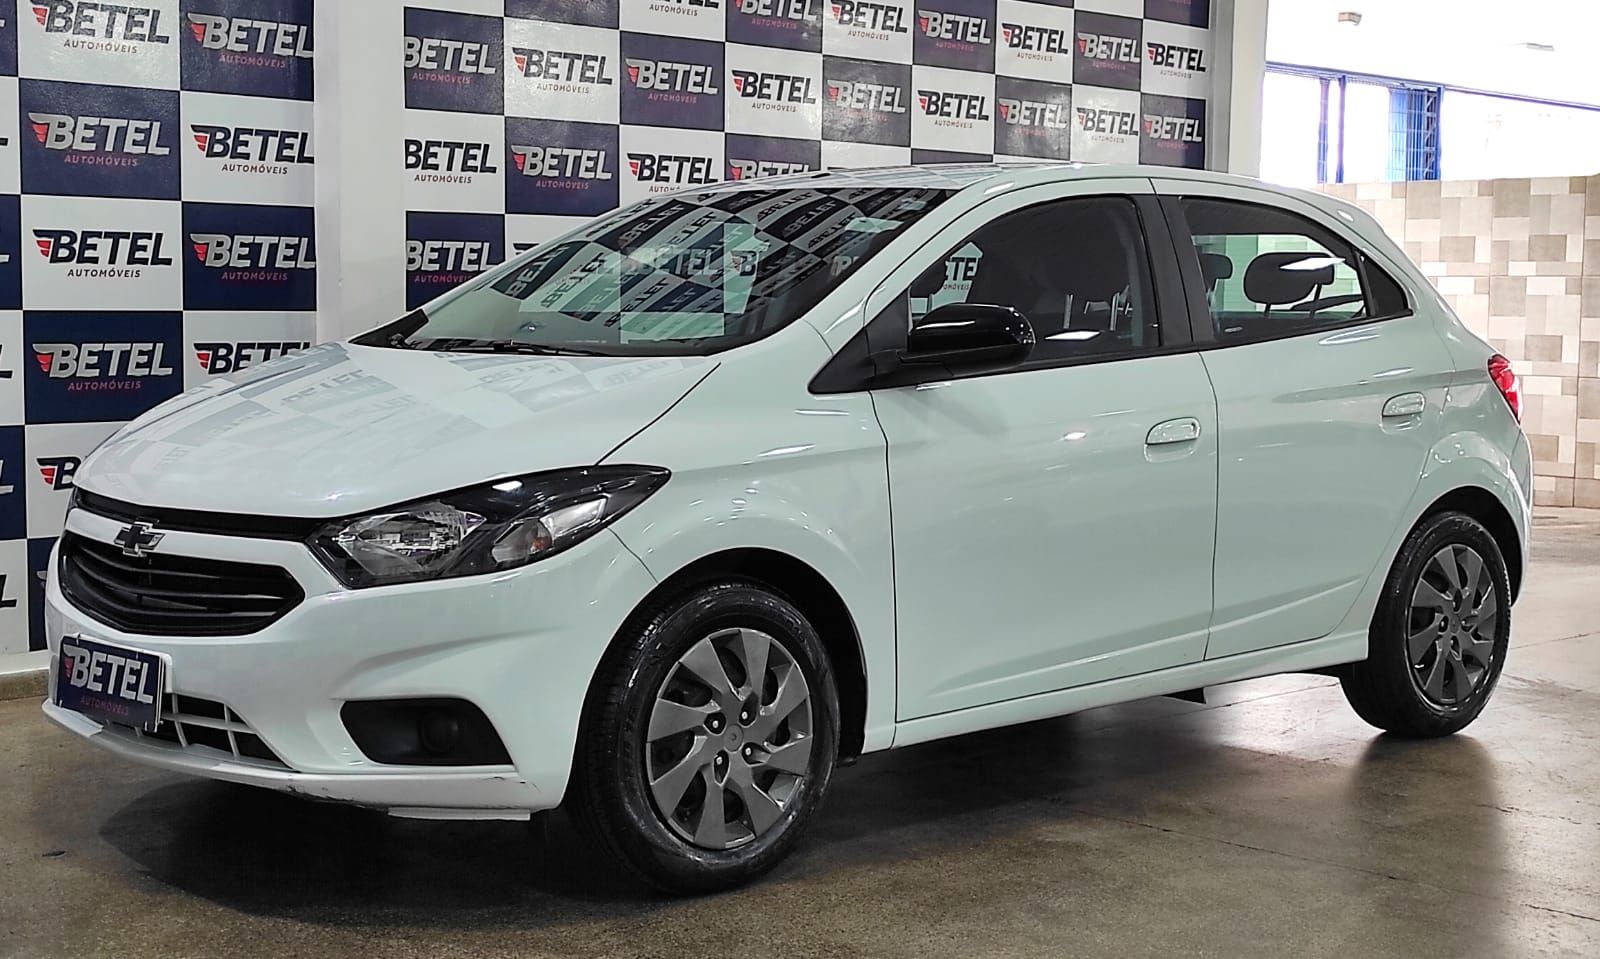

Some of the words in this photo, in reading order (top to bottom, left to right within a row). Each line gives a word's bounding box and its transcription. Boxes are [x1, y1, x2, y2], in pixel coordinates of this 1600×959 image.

[45, 0, 170, 45] BETEL
[838, 0, 908, 34] BETEL
[926, 10, 991, 45] BETEL
[64, 38, 138, 55] AUTOMÓVEIS
[202, 14, 314, 58] BETEL
[1008, 23, 1068, 55] BETEL
[1084, 33, 1141, 64] BETEL
[219, 53, 286, 69] AUTOMÓVEIS
[404, 36, 497, 75] BETEL
[523, 48, 613, 86] BETEL
[1153, 43, 1206, 73] BETEL
[636, 59, 719, 95] BETEL
[741, 70, 817, 105] BETEL
[836, 80, 906, 114] BETEL
[925, 90, 990, 121] BETEL
[1006, 99, 1068, 130] BETEL
[1083, 107, 1139, 137] BETEL
[1149, 114, 1203, 143] BETEL
[45, 113, 170, 156] BETEL
[205, 125, 315, 164] BETEL
[64, 154, 139, 168] AUTOMÓVEIS
[222, 163, 288, 175] AUTOMÓVEIS
[404, 138, 497, 174] BETEL
[522, 145, 613, 181] BETEL
[637, 153, 719, 185] BETEL
[414, 174, 473, 184] AUTOMÓVEIS
[536, 179, 590, 190] AUTOMÓVEIS
[49, 229, 173, 266] BETEL
[205, 234, 316, 269] BETEL
[405, 240, 500, 272] BETEL
[67, 268, 141, 278] AUTOMÓVEIS
[222, 271, 288, 281] AUTOMÓVEIS
[49, 343, 173, 378] BETEL
[68, 381, 141, 392] AUTOMÓVEIS
[69, 645, 154, 704] BETEL
